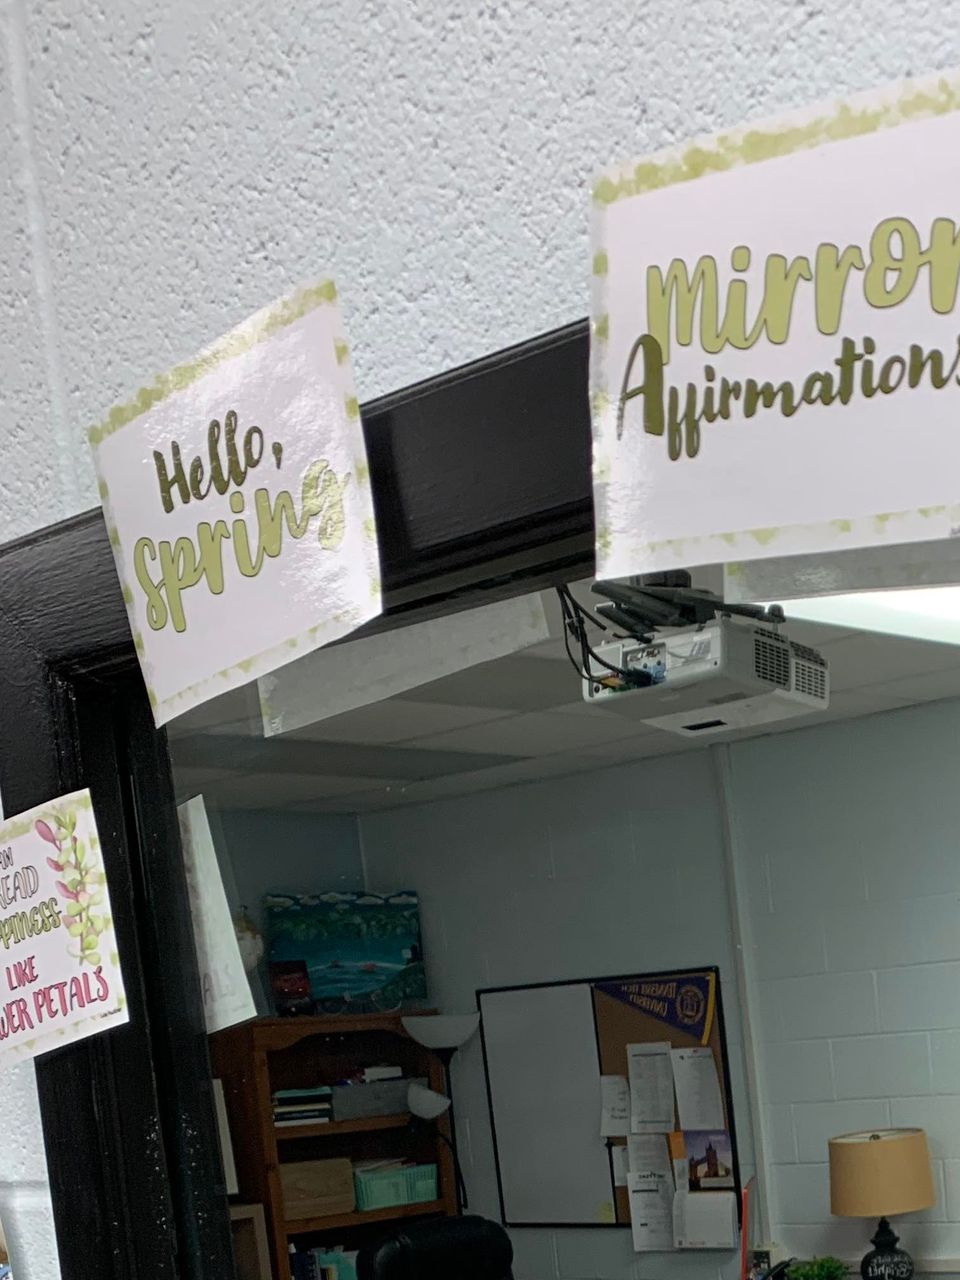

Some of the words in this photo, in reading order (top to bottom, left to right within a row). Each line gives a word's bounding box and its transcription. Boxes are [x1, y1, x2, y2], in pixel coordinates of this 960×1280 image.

[153, 411, 283, 513] Hello,
[0, 865, 39, 909] EAD
[0, 897, 62, 949] PINESS
[6, 955, 39, 991] LIKE
[33, 966, 109, 1023] PETALS
